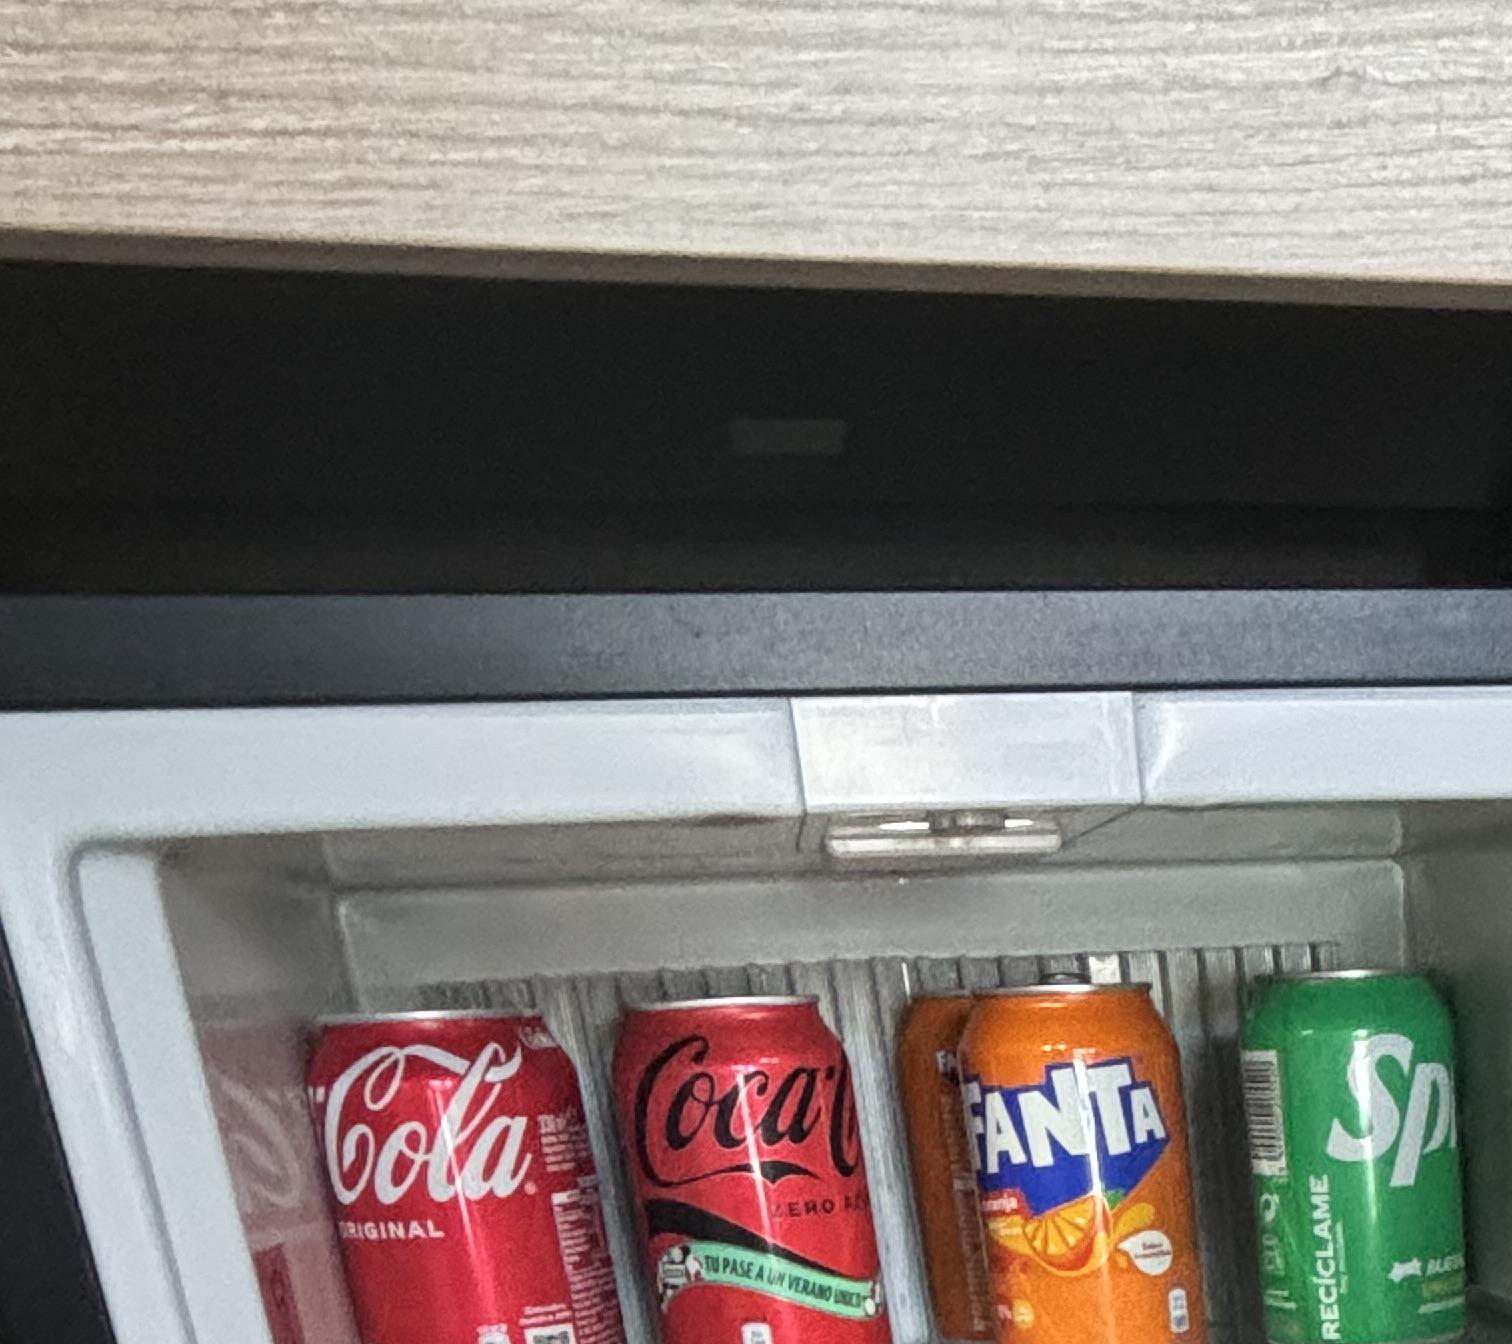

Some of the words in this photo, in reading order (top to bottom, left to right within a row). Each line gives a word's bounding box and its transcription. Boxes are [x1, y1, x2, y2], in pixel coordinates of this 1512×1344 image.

[965, 1064, 1166, 1173] FANTA
[1326, 1034, 1457, 1187] Sp
[722, 1255, 754, 1278] PASE
[755, 1268, 764, 1282] A
[787, 1276, 832, 1301] VERANO
